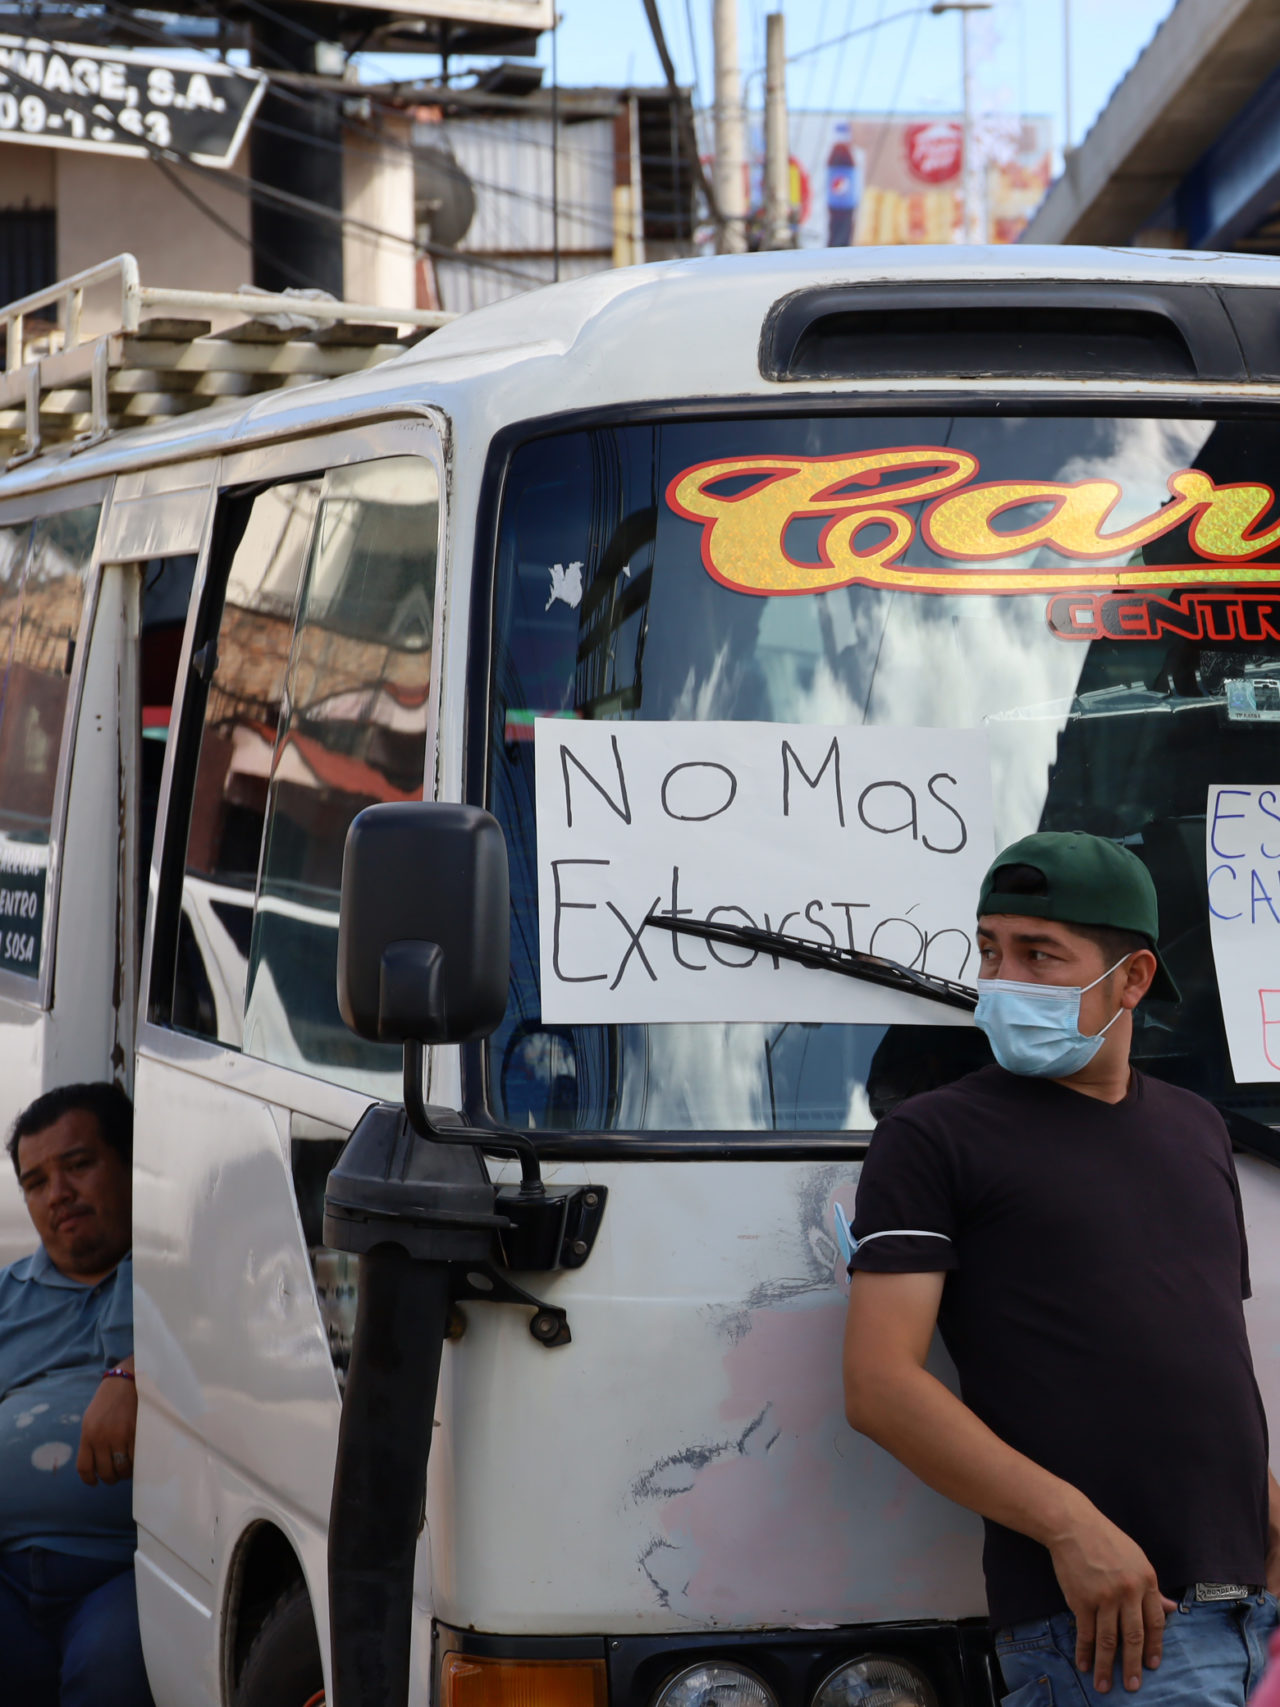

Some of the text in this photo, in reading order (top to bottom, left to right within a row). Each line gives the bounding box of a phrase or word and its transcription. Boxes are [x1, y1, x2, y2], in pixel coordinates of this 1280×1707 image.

[147, 68, 228, 114] S.A.
[559, 734, 968, 854] No Mas
[4, 930, 35, 963] SOSA
